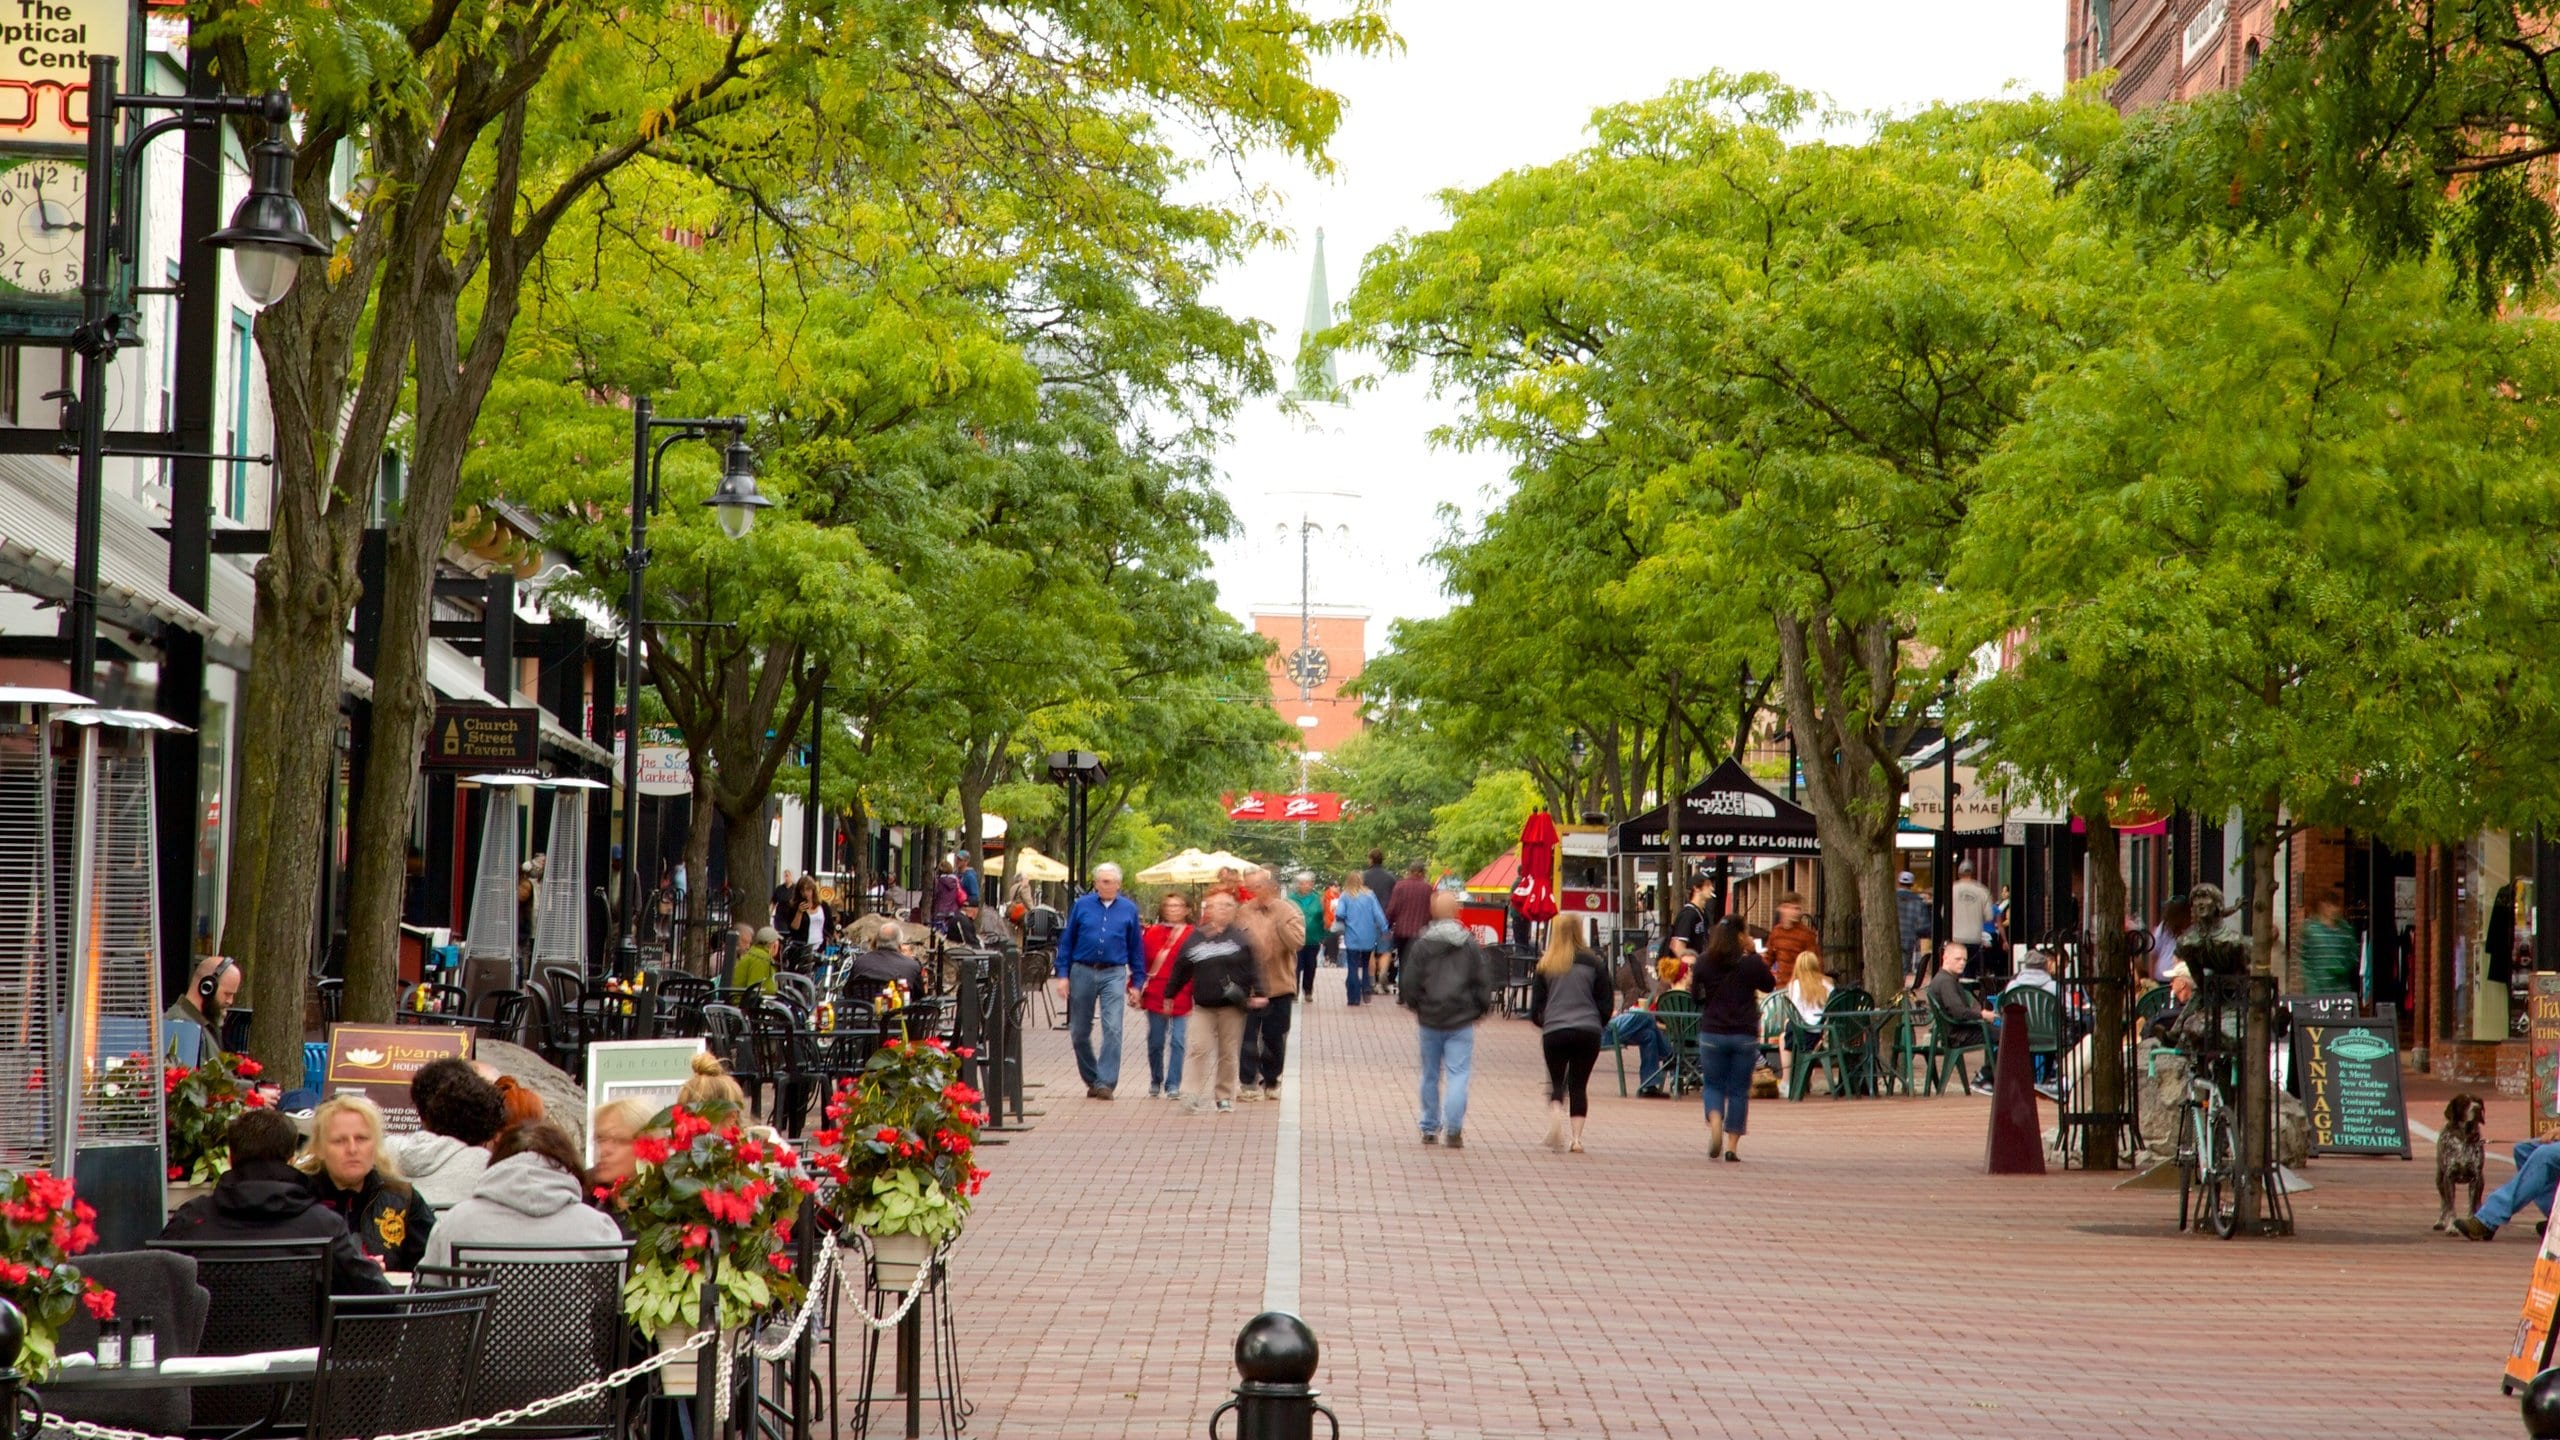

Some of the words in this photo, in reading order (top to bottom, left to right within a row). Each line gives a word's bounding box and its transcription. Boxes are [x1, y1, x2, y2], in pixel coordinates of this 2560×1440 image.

[17, 0, 72, 20] The
[0, 22, 86, 45] ptical
[18, 46, 88, 69] Cent
[0, 188, 14, 207] 0
[463, 718, 518, 732] Church
[468, 731, 514, 744] Street
[464, 743, 516, 757] Tavern
[637, 753, 656, 768] he
[1711, 791, 1744, 800] THE
[1687, 798, 1744, 808] NORTH
[1913, 802, 1964, 814] STELA
[1969, 803, 1999, 814] MAE
[1703, 807, 1745, 816] FACE
[1642, 834, 1690, 846] NEVR
[1696, 834, 1734, 846] STOP
[1739, 834, 1821, 849] EXPLORING
[386, 1044, 450, 1062] jivana
[2338, 1060, 2372, 1070] Womens
[2349, 1070, 2371, 1079] Mens
[2306, 1026, 2334, 1146] VINTAGE
[2340, 1079, 2357, 1087] New
[2358, 1080, 2389, 1089] Clothes
[2340, 1088, 2387, 1098] Accessories
[2340, 1097, 2381, 1107] Costumes
[404, 1108, 419, 1116] ON
[2341, 1106, 2365, 1115] Local
[2367, 1107, 2396, 1117] Artists
[2342, 1115, 2372, 1126] Jewelry
[2343, 1124, 2373, 1134] Hipster
[2374, 1125, 2396, 1135] Crap
[2334, 1133, 2401, 1148] UPSTAIRS
